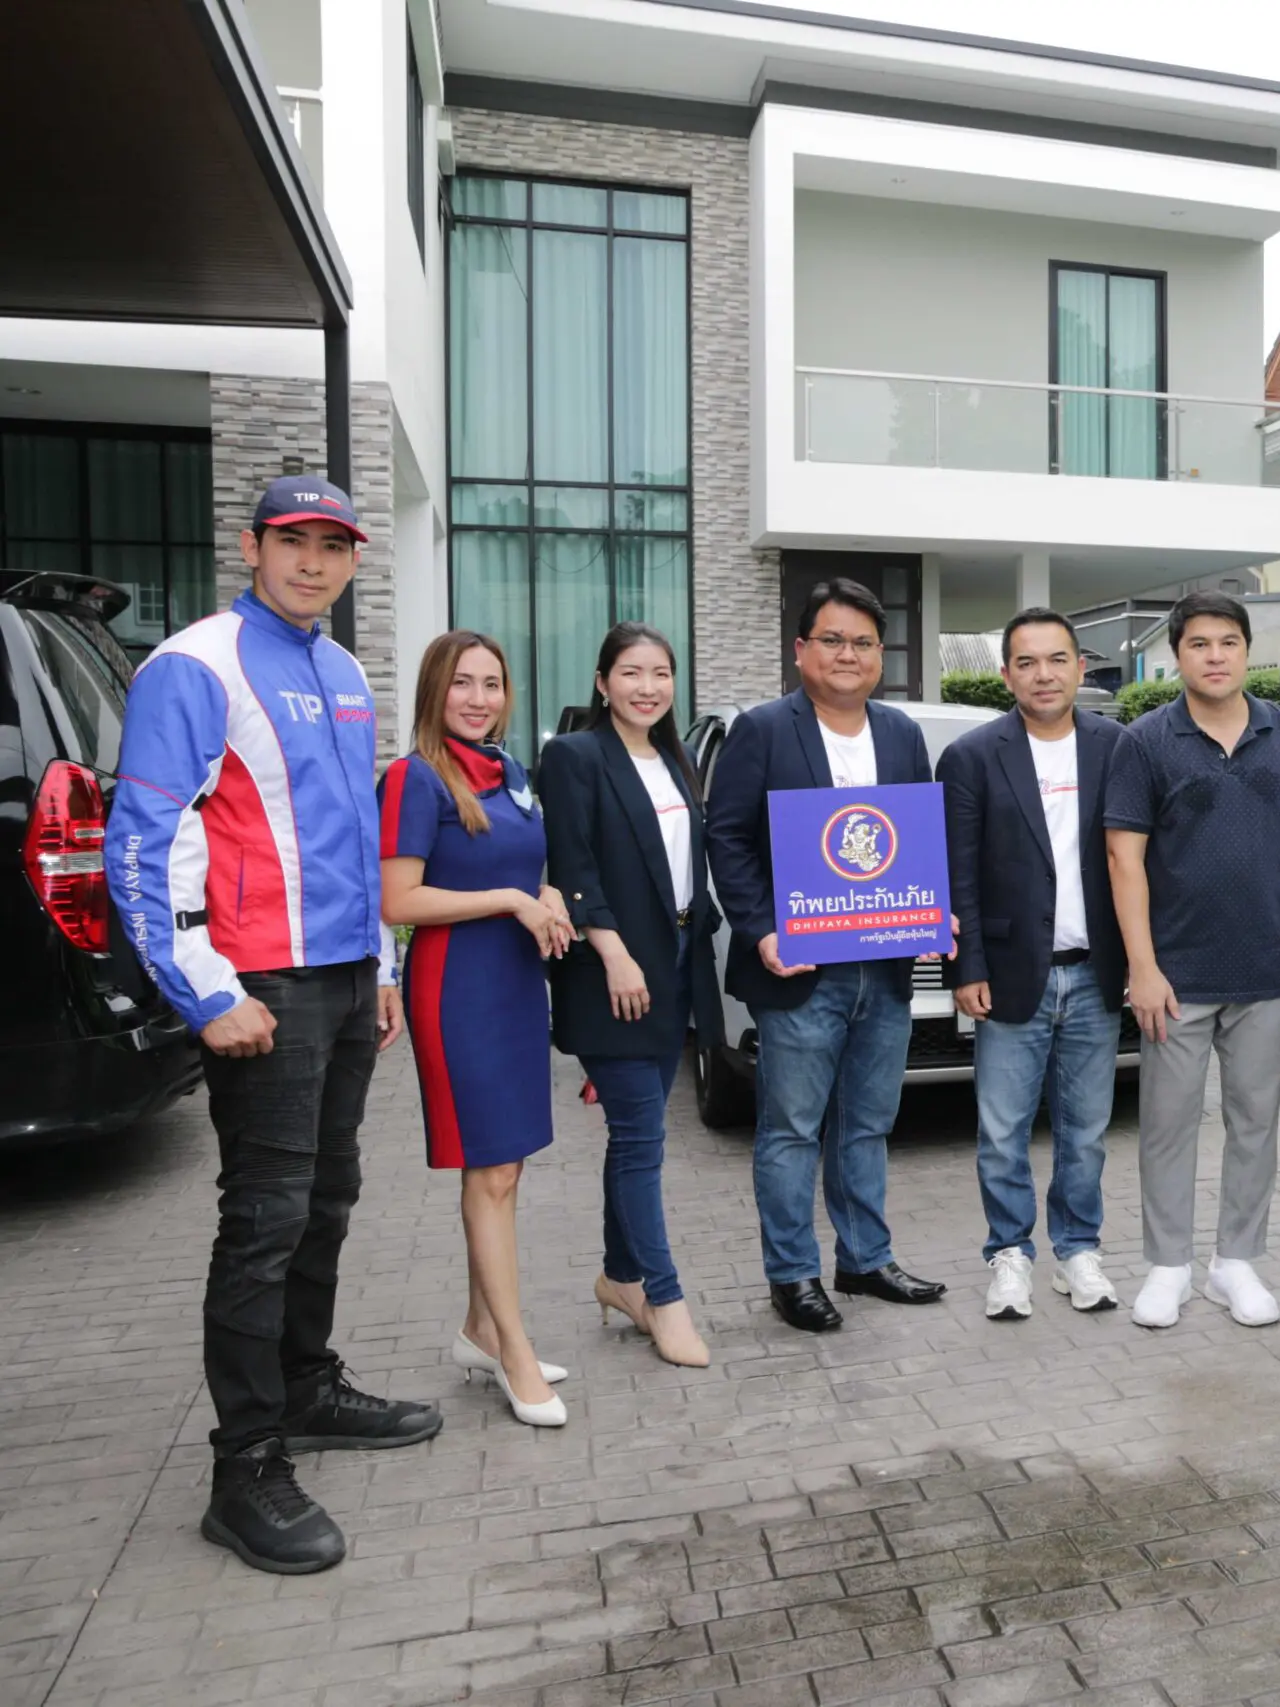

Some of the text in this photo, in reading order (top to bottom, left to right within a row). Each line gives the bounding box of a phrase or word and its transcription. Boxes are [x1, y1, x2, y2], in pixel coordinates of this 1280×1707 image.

[293, 492, 320, 502] TIP
[278, 690, 323, 724] TIP
[336, 694, 368, 708] SMART
[124, 835, 142, 902] DHIPAYA
[788, 884, 935, 915] ทิพยประกันภัย
[793, 912, 937, 931] DHIPAYA INSURANCE
